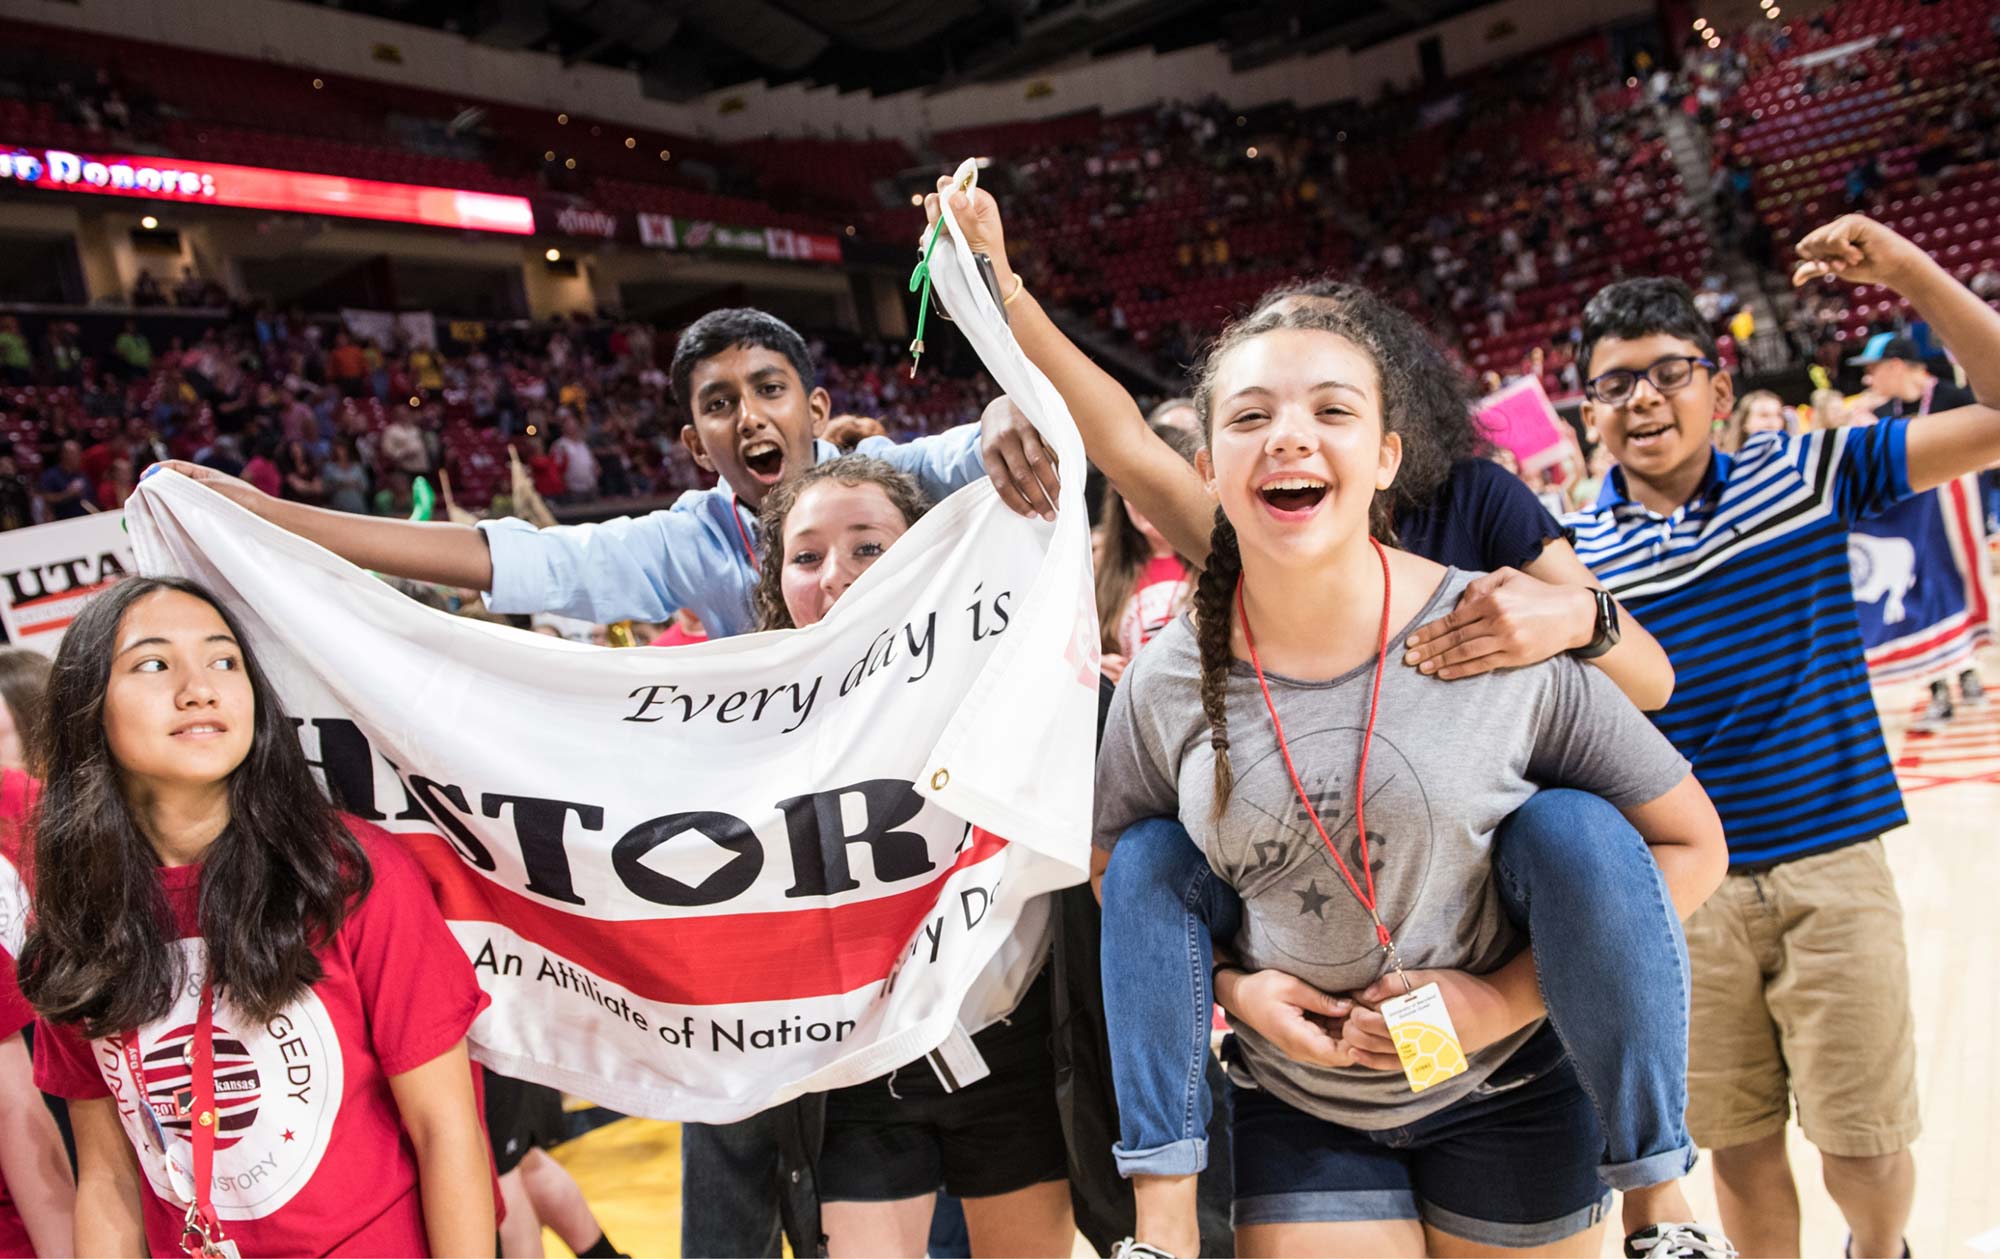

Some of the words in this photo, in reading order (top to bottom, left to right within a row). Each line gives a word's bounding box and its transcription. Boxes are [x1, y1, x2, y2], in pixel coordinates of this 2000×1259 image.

[45, 150, 215, 197] Donors:
[1, 547, 134, 605] UTA
[622, 675, 823, 734] Every
[839, 610, 937, 698] day
[965, 581, 1012, 642] is
[474, 938, 523, 976] An
[536, 955, 648, 1031] Affiliate
[658, 1016, 695, 1048] of
[215, 1078, 257, 1092] kansas
[212, 1152, 278, 1192] ISTORY
